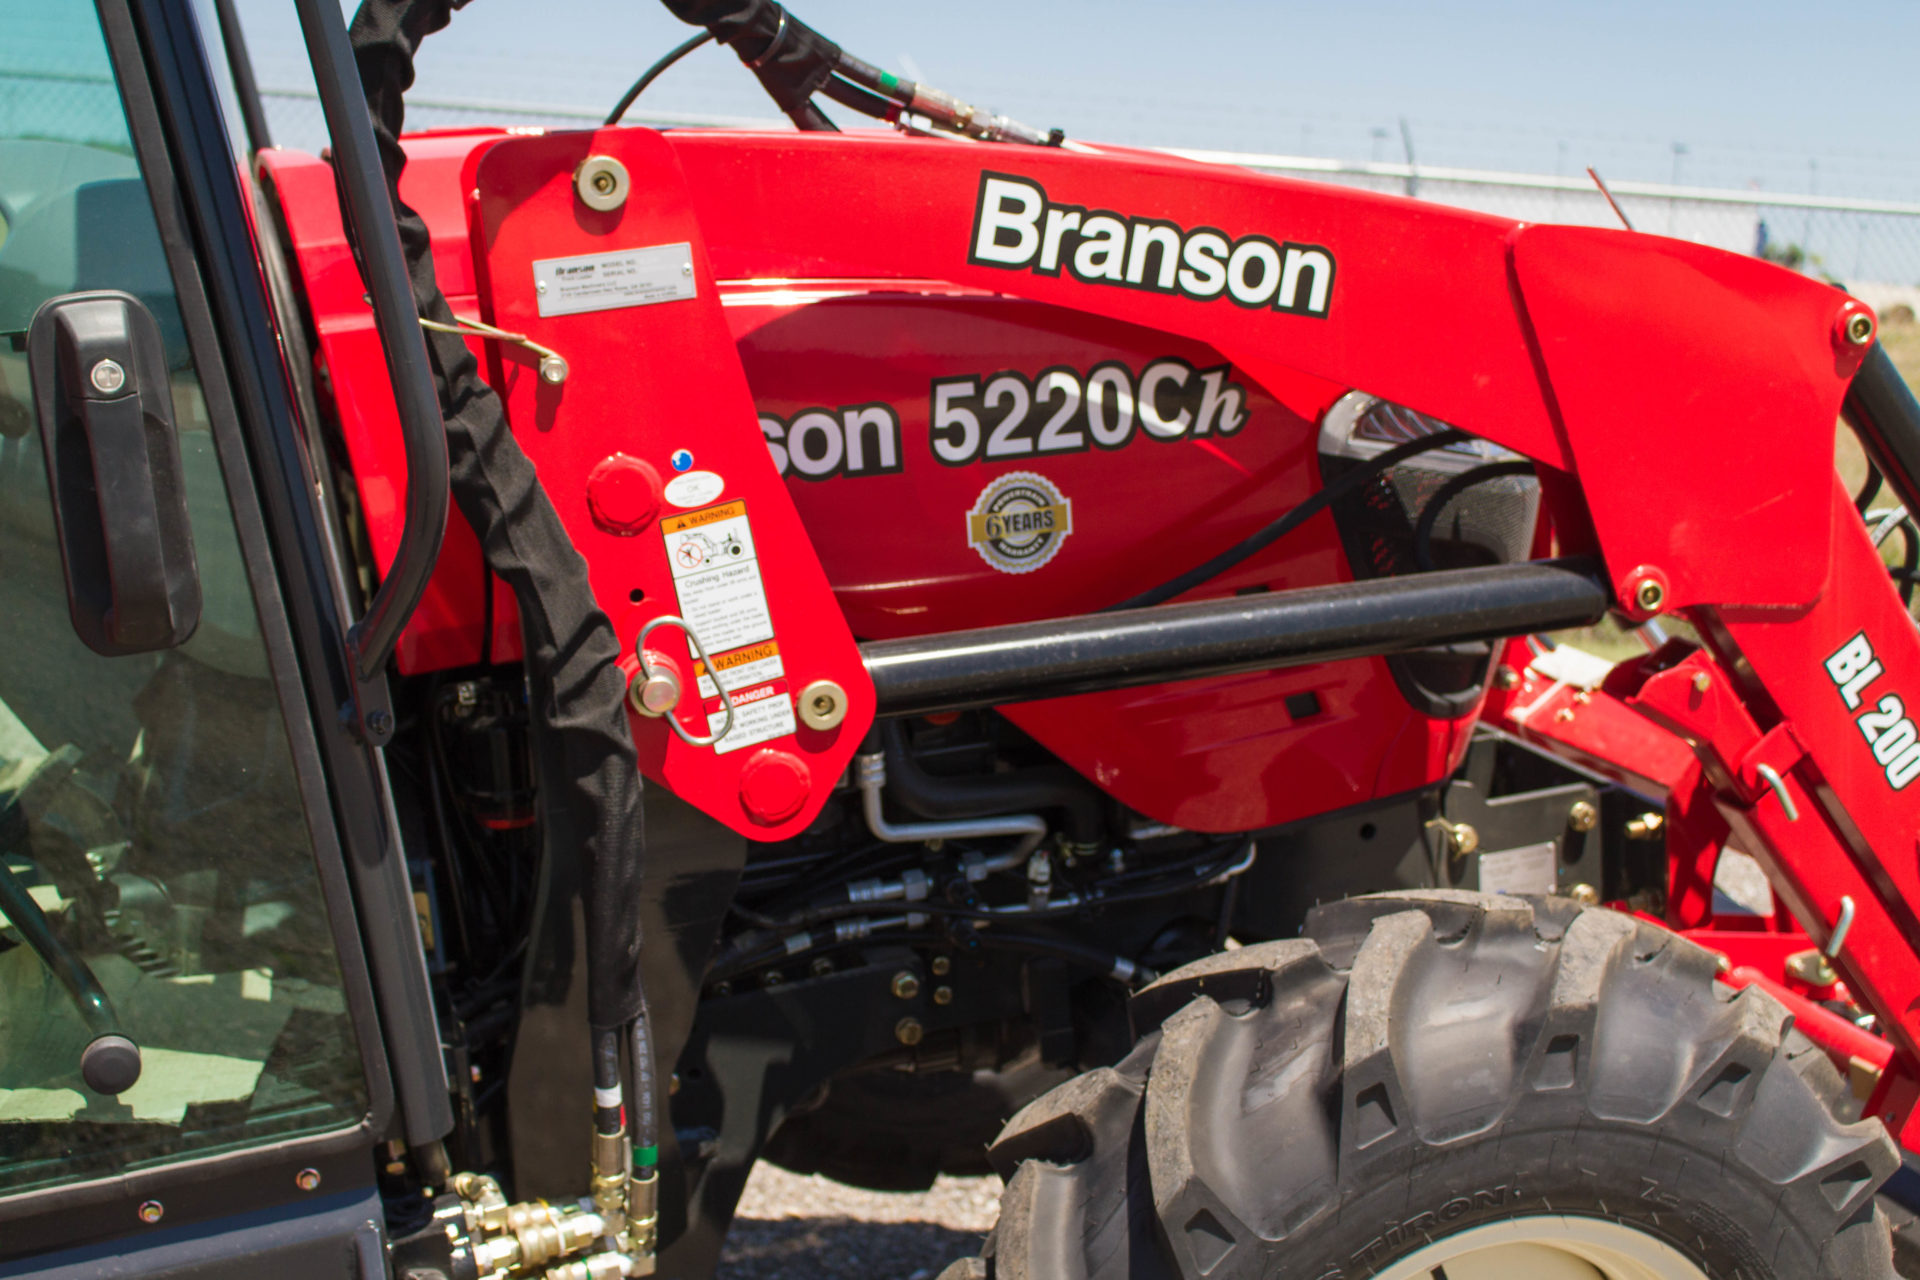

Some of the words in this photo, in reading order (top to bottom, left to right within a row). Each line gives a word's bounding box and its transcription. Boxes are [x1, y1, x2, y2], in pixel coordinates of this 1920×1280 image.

[973, 175, 1332, 314] Branson
[931, 361, 1247, 463] 5220Ch
[689, 507, 736, 525] WARNING
[684, 573, 720, 588] Crushing
[715, 645, 773, 670] WARNING
[730, 685, 775, 707] DANGER
[1824, 631, 1884, 713] BL
[1855, 693, 1920, 790] 200
